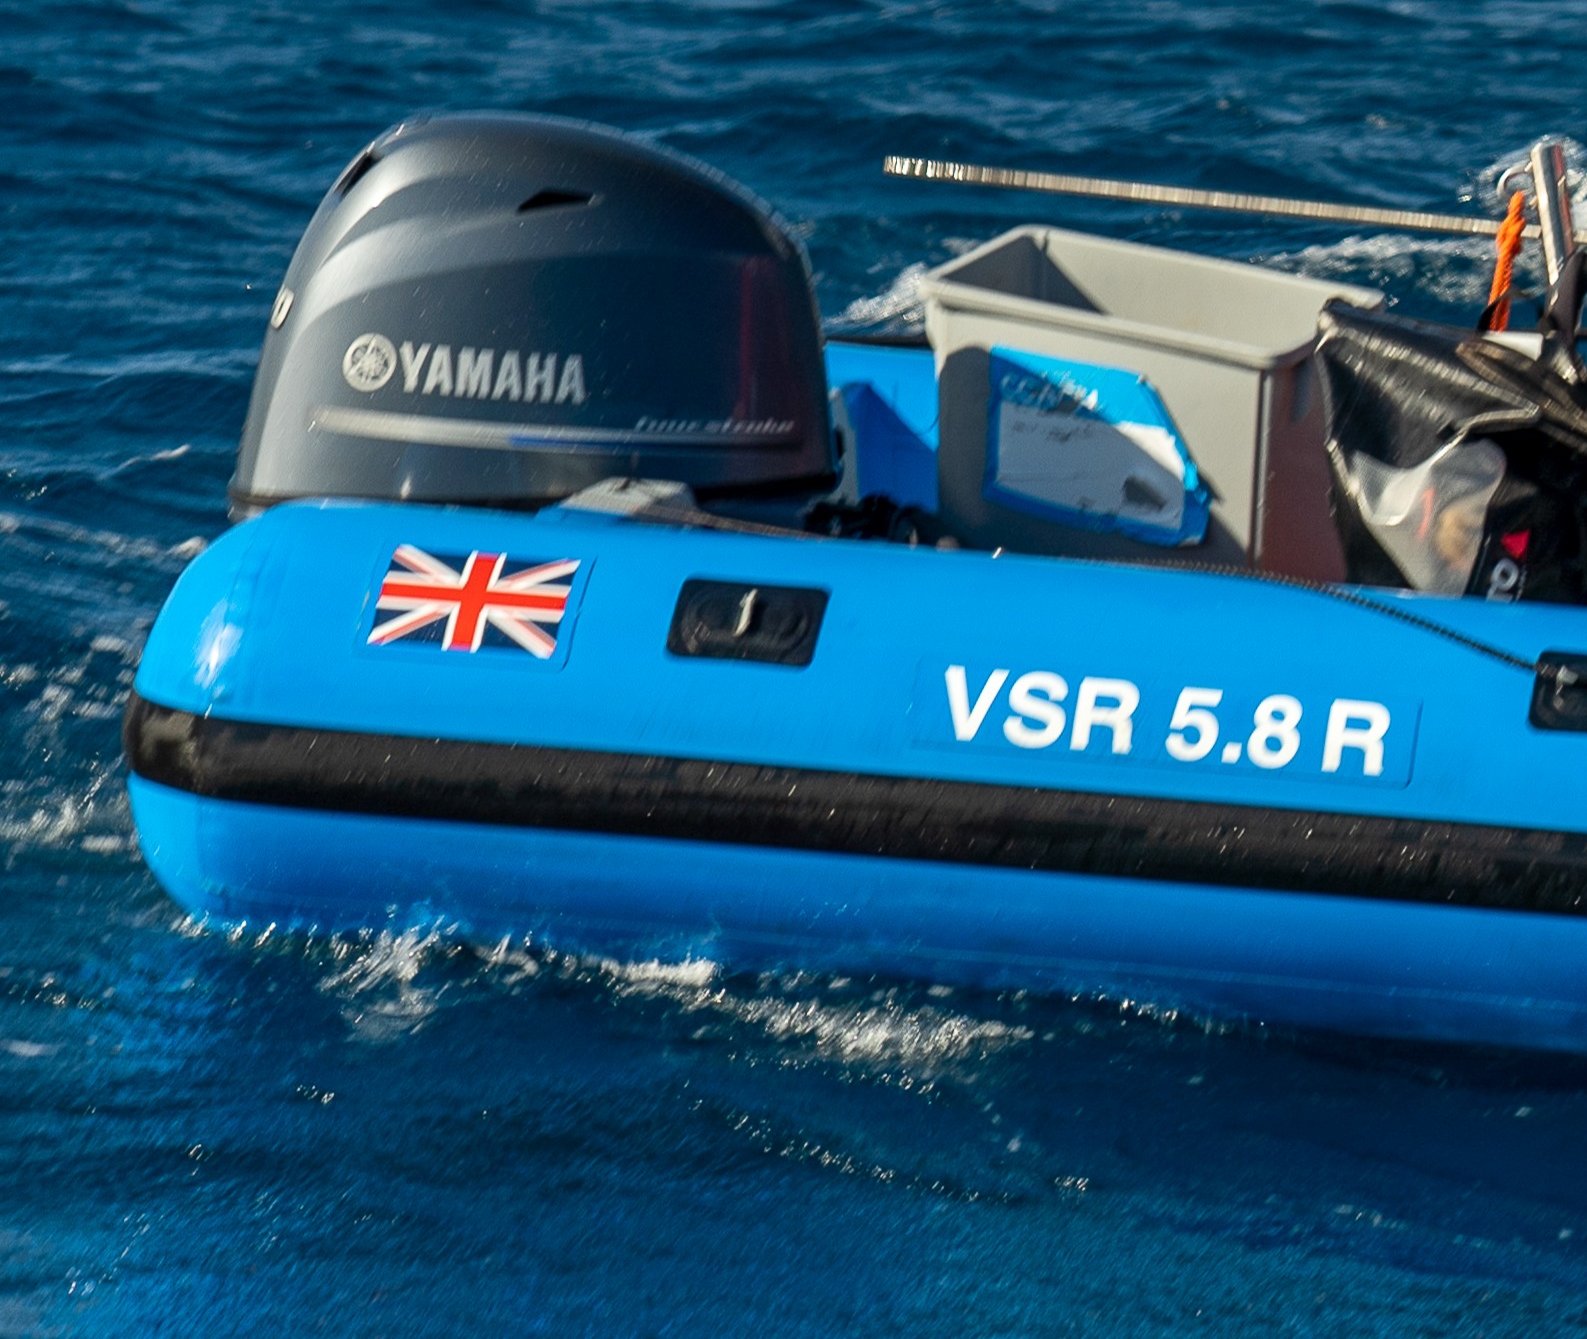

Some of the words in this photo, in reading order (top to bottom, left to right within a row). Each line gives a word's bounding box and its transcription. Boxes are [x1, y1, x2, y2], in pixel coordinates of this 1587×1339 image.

[399, 339, 587, 406] YAMAHA
[944, 664, 1141, 755] VSR
[1164, 686, 1304, 770] 5.8
[1321, 697, 1391, 777] R
